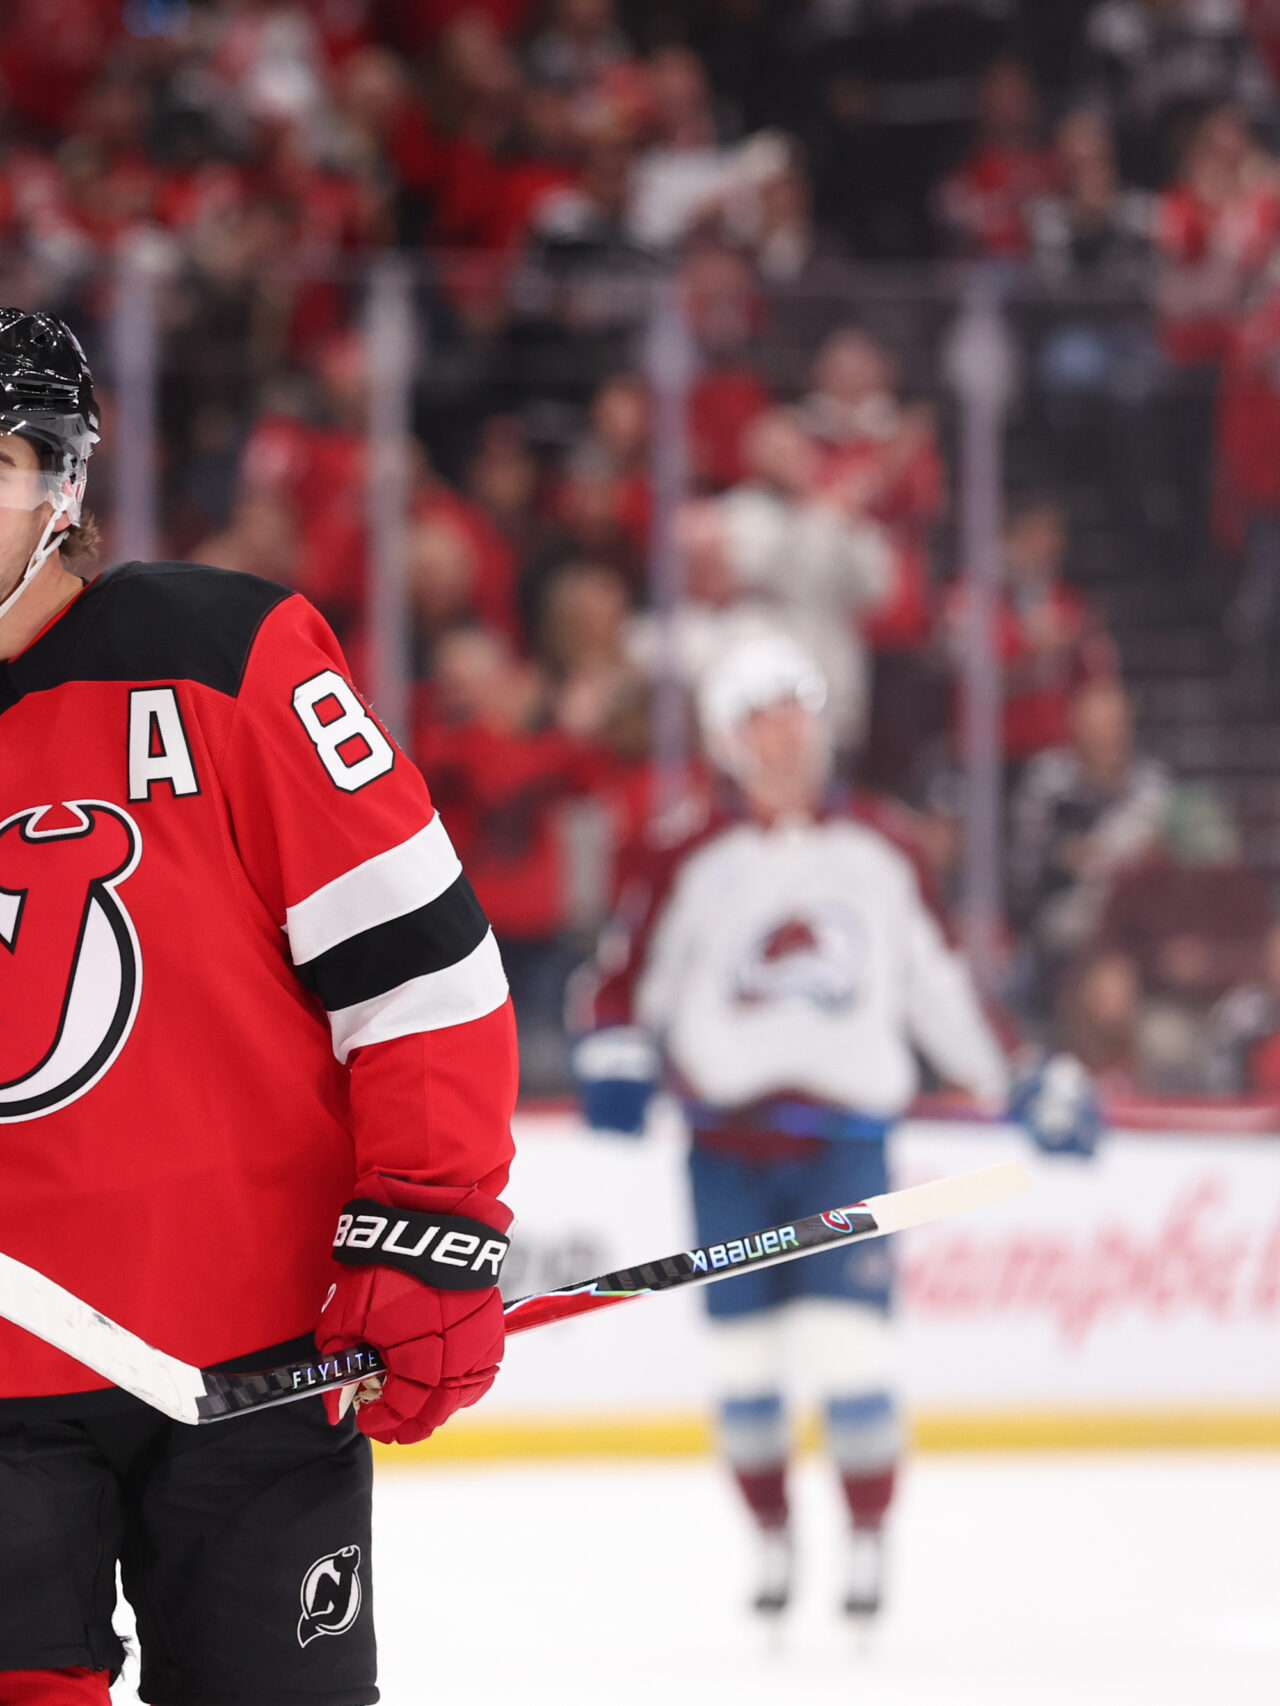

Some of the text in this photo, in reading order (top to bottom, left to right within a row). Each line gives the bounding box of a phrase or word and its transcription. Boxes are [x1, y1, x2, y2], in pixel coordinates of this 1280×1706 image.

[127, 684, 202, 803] A
[332, 1214, 508, 1276] BAUER
[709, 1226, 800, 1269] BAUER
[292, 1352, 378, 1390] FLYLITE
